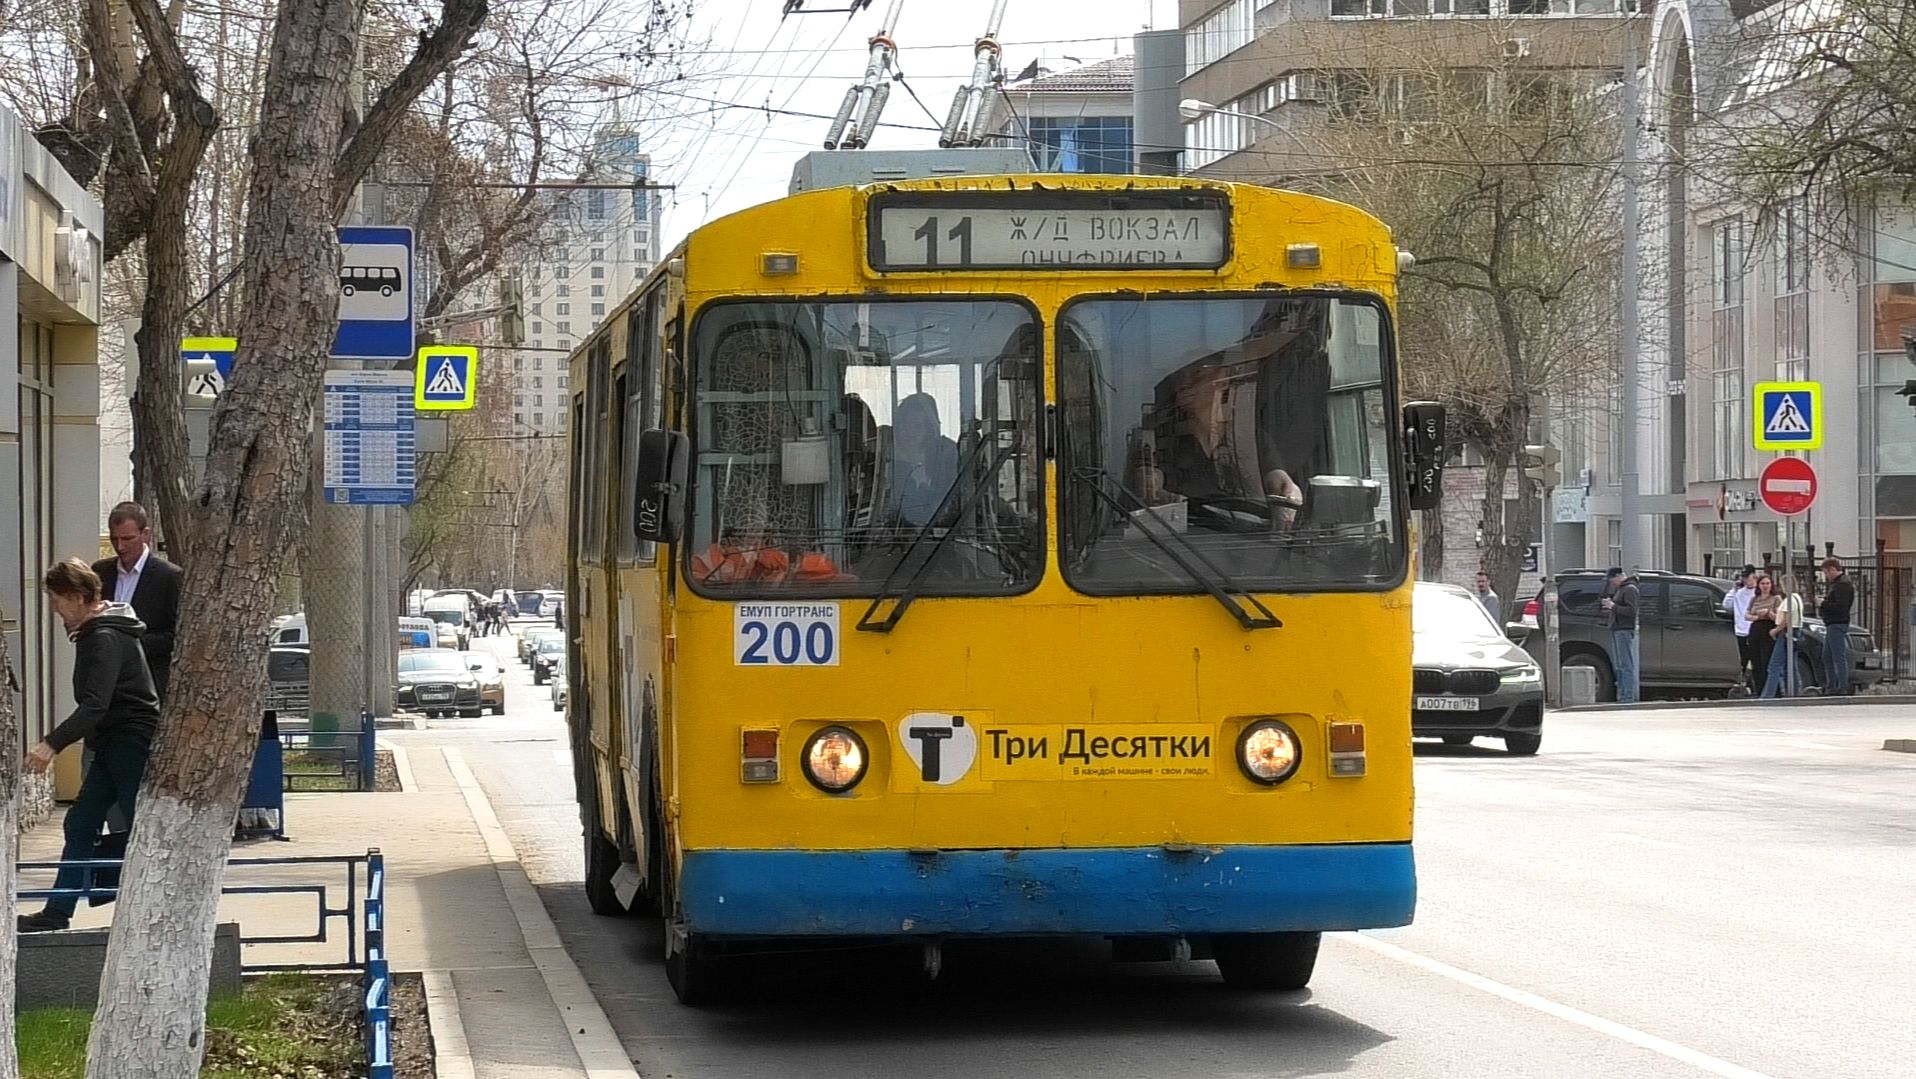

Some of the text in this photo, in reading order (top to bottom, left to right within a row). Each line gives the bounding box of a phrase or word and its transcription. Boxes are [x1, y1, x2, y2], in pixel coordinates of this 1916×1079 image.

[914, 216, 1199, 264] 11 Ж/Д ВОКЗАЛ
[740, 605, 833, 617] ЕМУП ГОРТРАНС
[740, 621, 833, 665] 200
[985, 729, 1210, 765] Три Десятки
[1073, 766, 1080, 776] В
[1082, 766, 1116, 777] каждой
[1118, 767, 1153, 776] машине
[1161, 768, 1181, 776] свои
